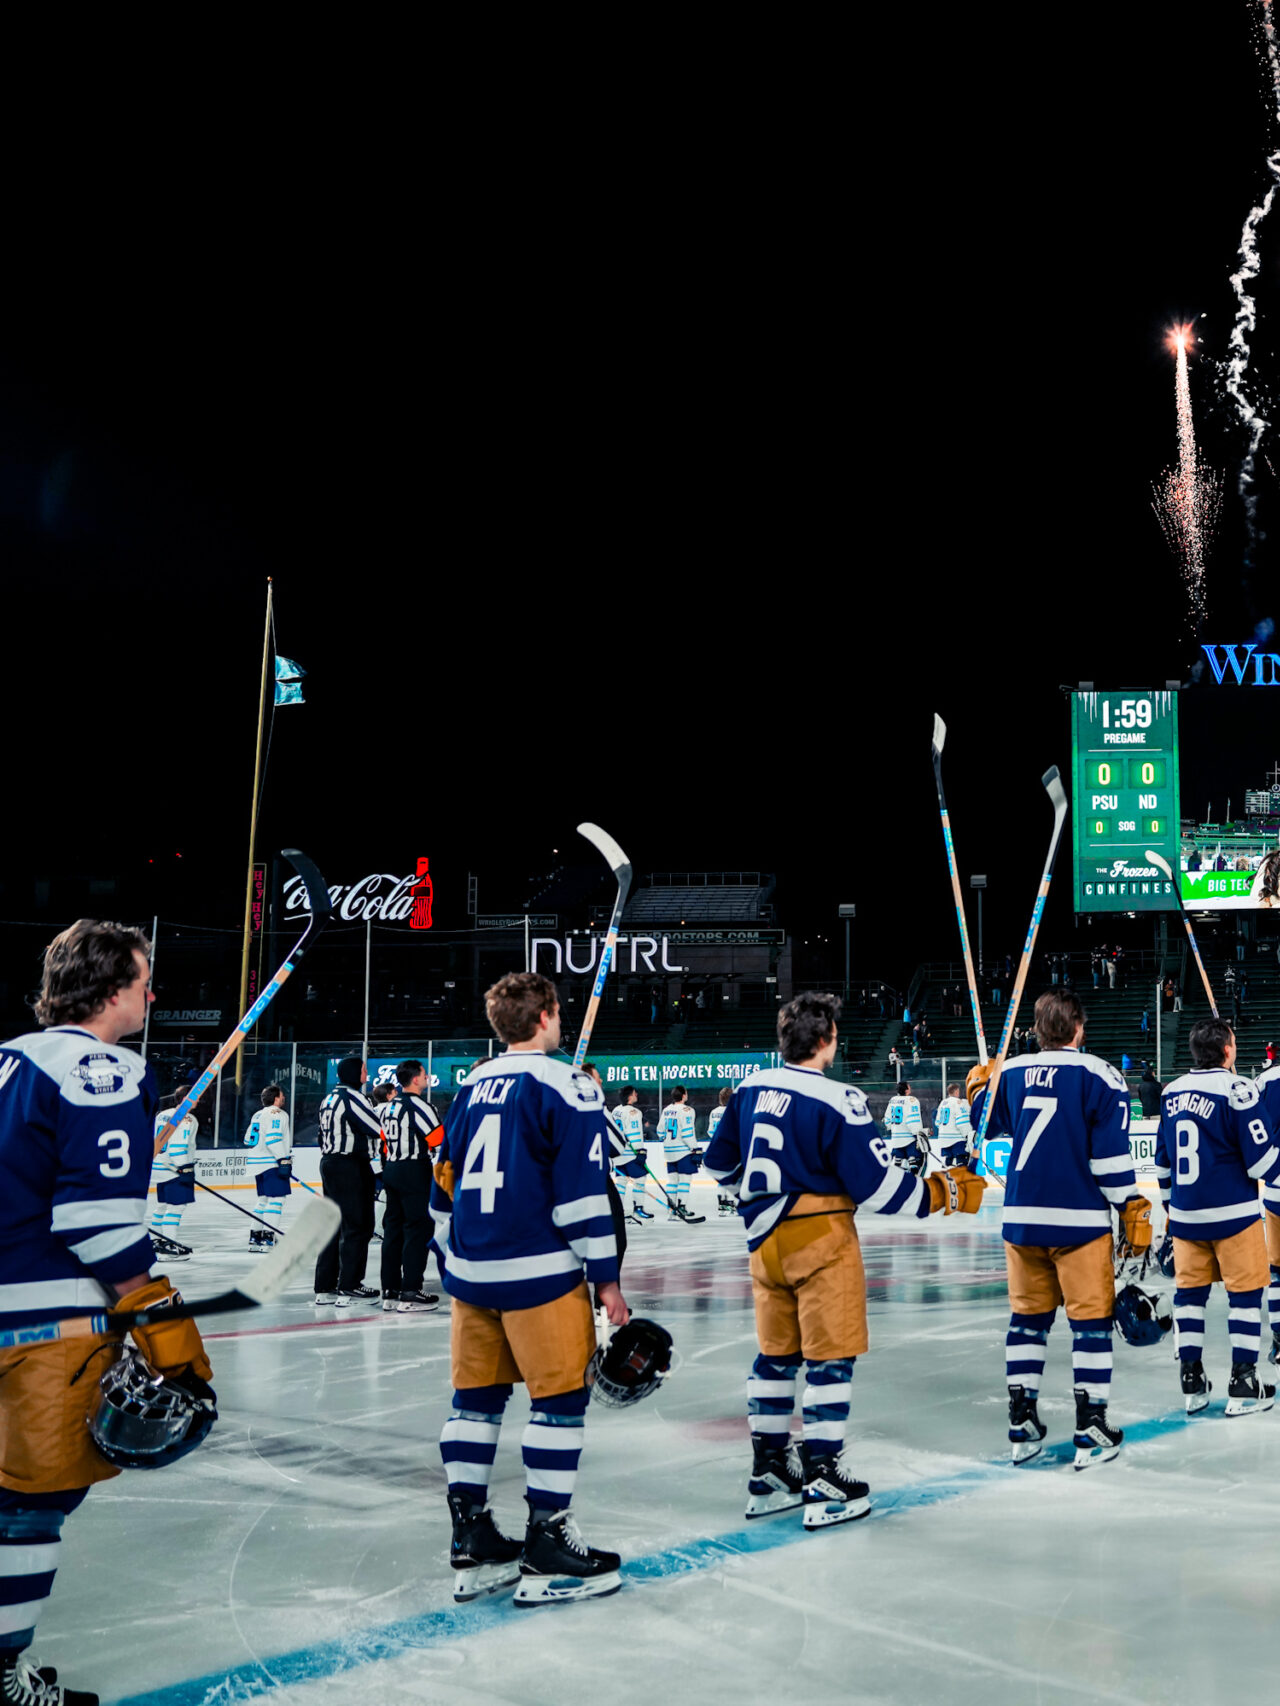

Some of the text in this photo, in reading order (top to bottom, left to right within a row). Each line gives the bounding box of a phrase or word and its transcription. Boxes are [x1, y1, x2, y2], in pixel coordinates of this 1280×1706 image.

[1102, 699, 1152, 728] 1:59
[1104, 733, 1146, 744] PREGAME
[1098, 762, 1154, 785] 0 0
[1092, 794, 1157, 810] PSU ND
[1095, 820, 1159, 834] 0 SOG 0
[1110, 860, 1159, 877] Frozen
[282, 874, 420, 920] Coa-Cola
[1085, 882, 1171, 896] CONFINES
[1208, 879, 1226, 892] BIG
[153, 1010, 222, 1020] GRAINGER
[274, 1063, 321, 1084] JIM BEAM
[607, 1064, 760, 1081] BIG TEN HOCKEY SERIES
[1024, 1067, 1058, 1088] DYCK
[467, 1077, 517, 1108] MACK
[754, 1090, 792, 1118] DOWD
[1118, 1101, 1128, 1130] 7
[384, 1119, 399, 1140] 20
[1015, 1096, 1058, 1171] 7
[1247, 1119, 1268, 1145] 8
[98, 1129, 131, 1178] 3
[588, 1133, 604, 1170] 4
[740, 1122, 784, 1202] 6
[869, 1138, 892, 1168] 6
[201, 1168, 246, 1177] BIG TEN HOC
[460, 1113, 504, 1214] 4
